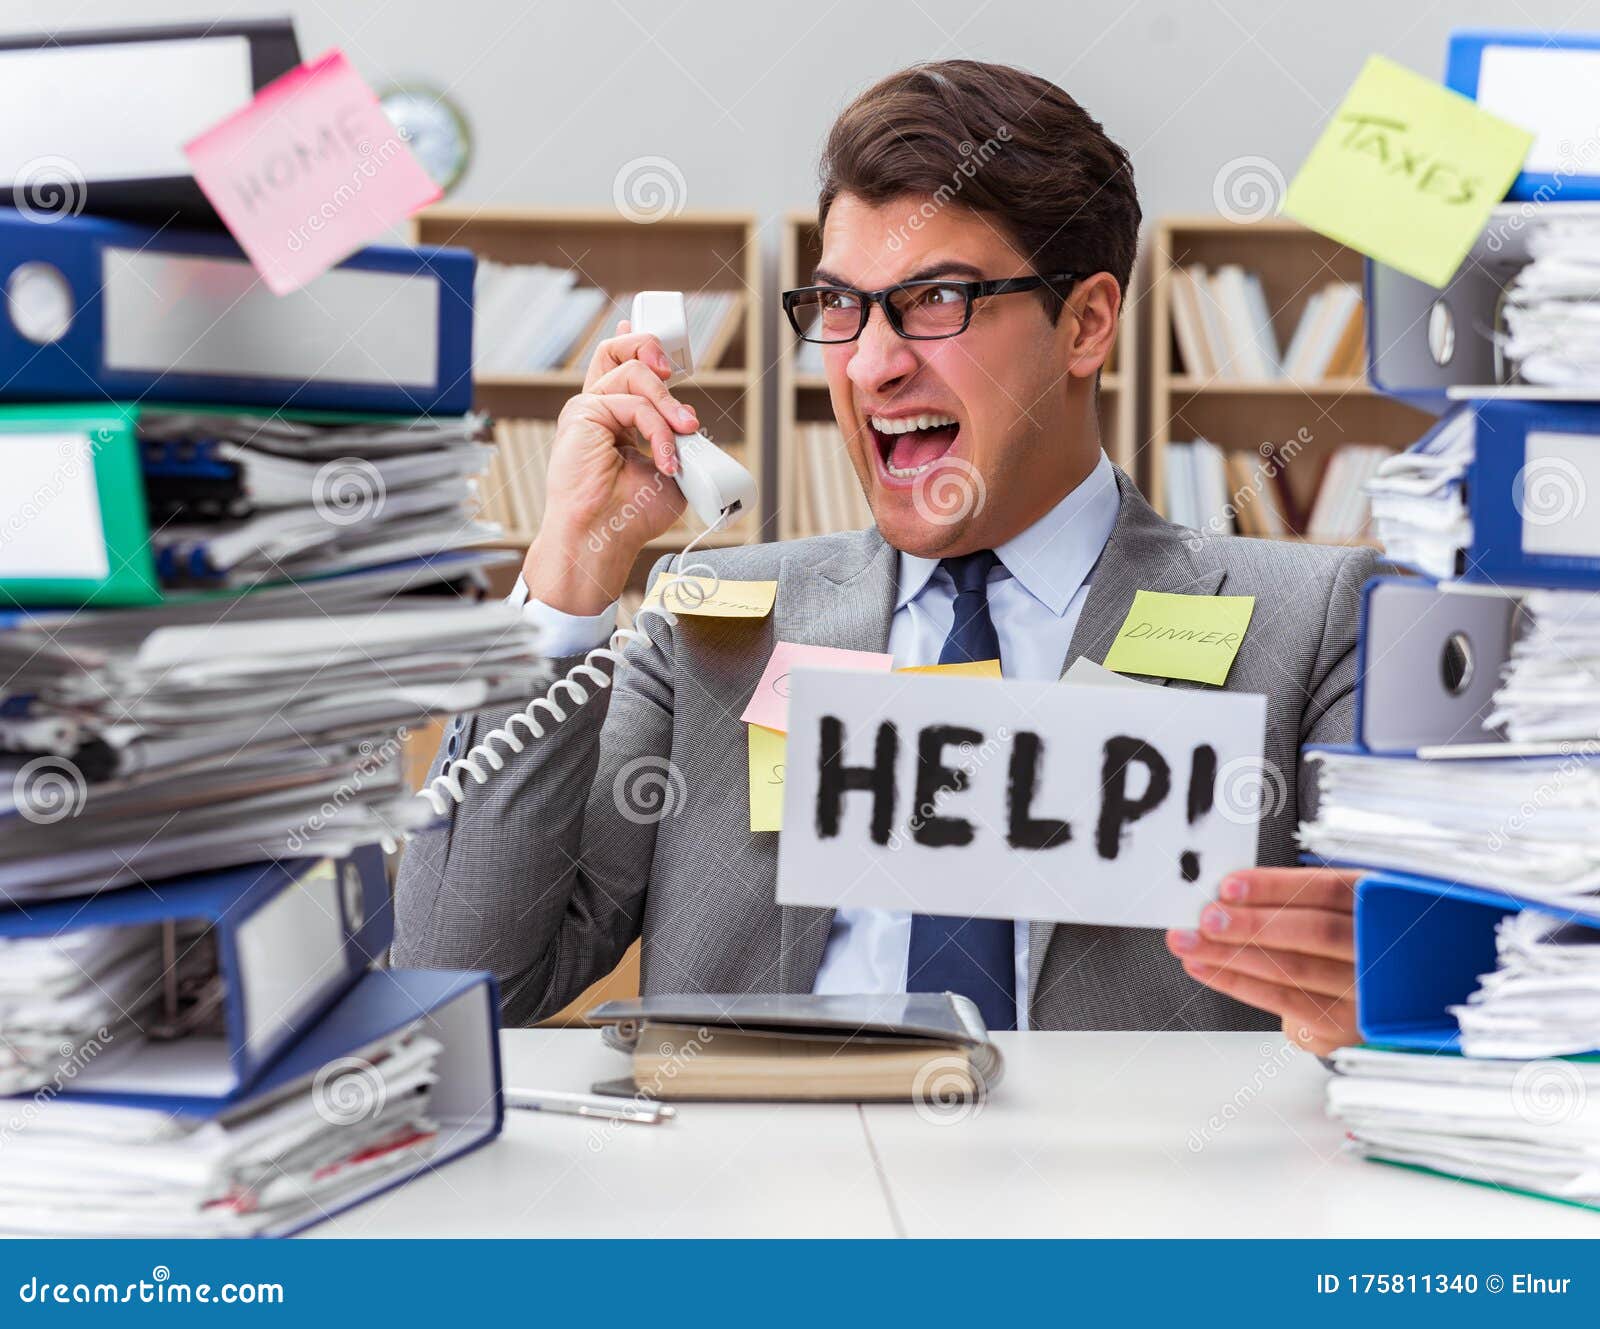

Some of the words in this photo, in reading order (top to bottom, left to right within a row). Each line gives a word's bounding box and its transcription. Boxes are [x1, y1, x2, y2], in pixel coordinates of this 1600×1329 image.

[232, 103, 366, 213] HOME
[1340, 113, 1483, 205] TAXES
[1125, 622, 1239, 649] DINNER
[816, 715, 1217, 882] HELP!
